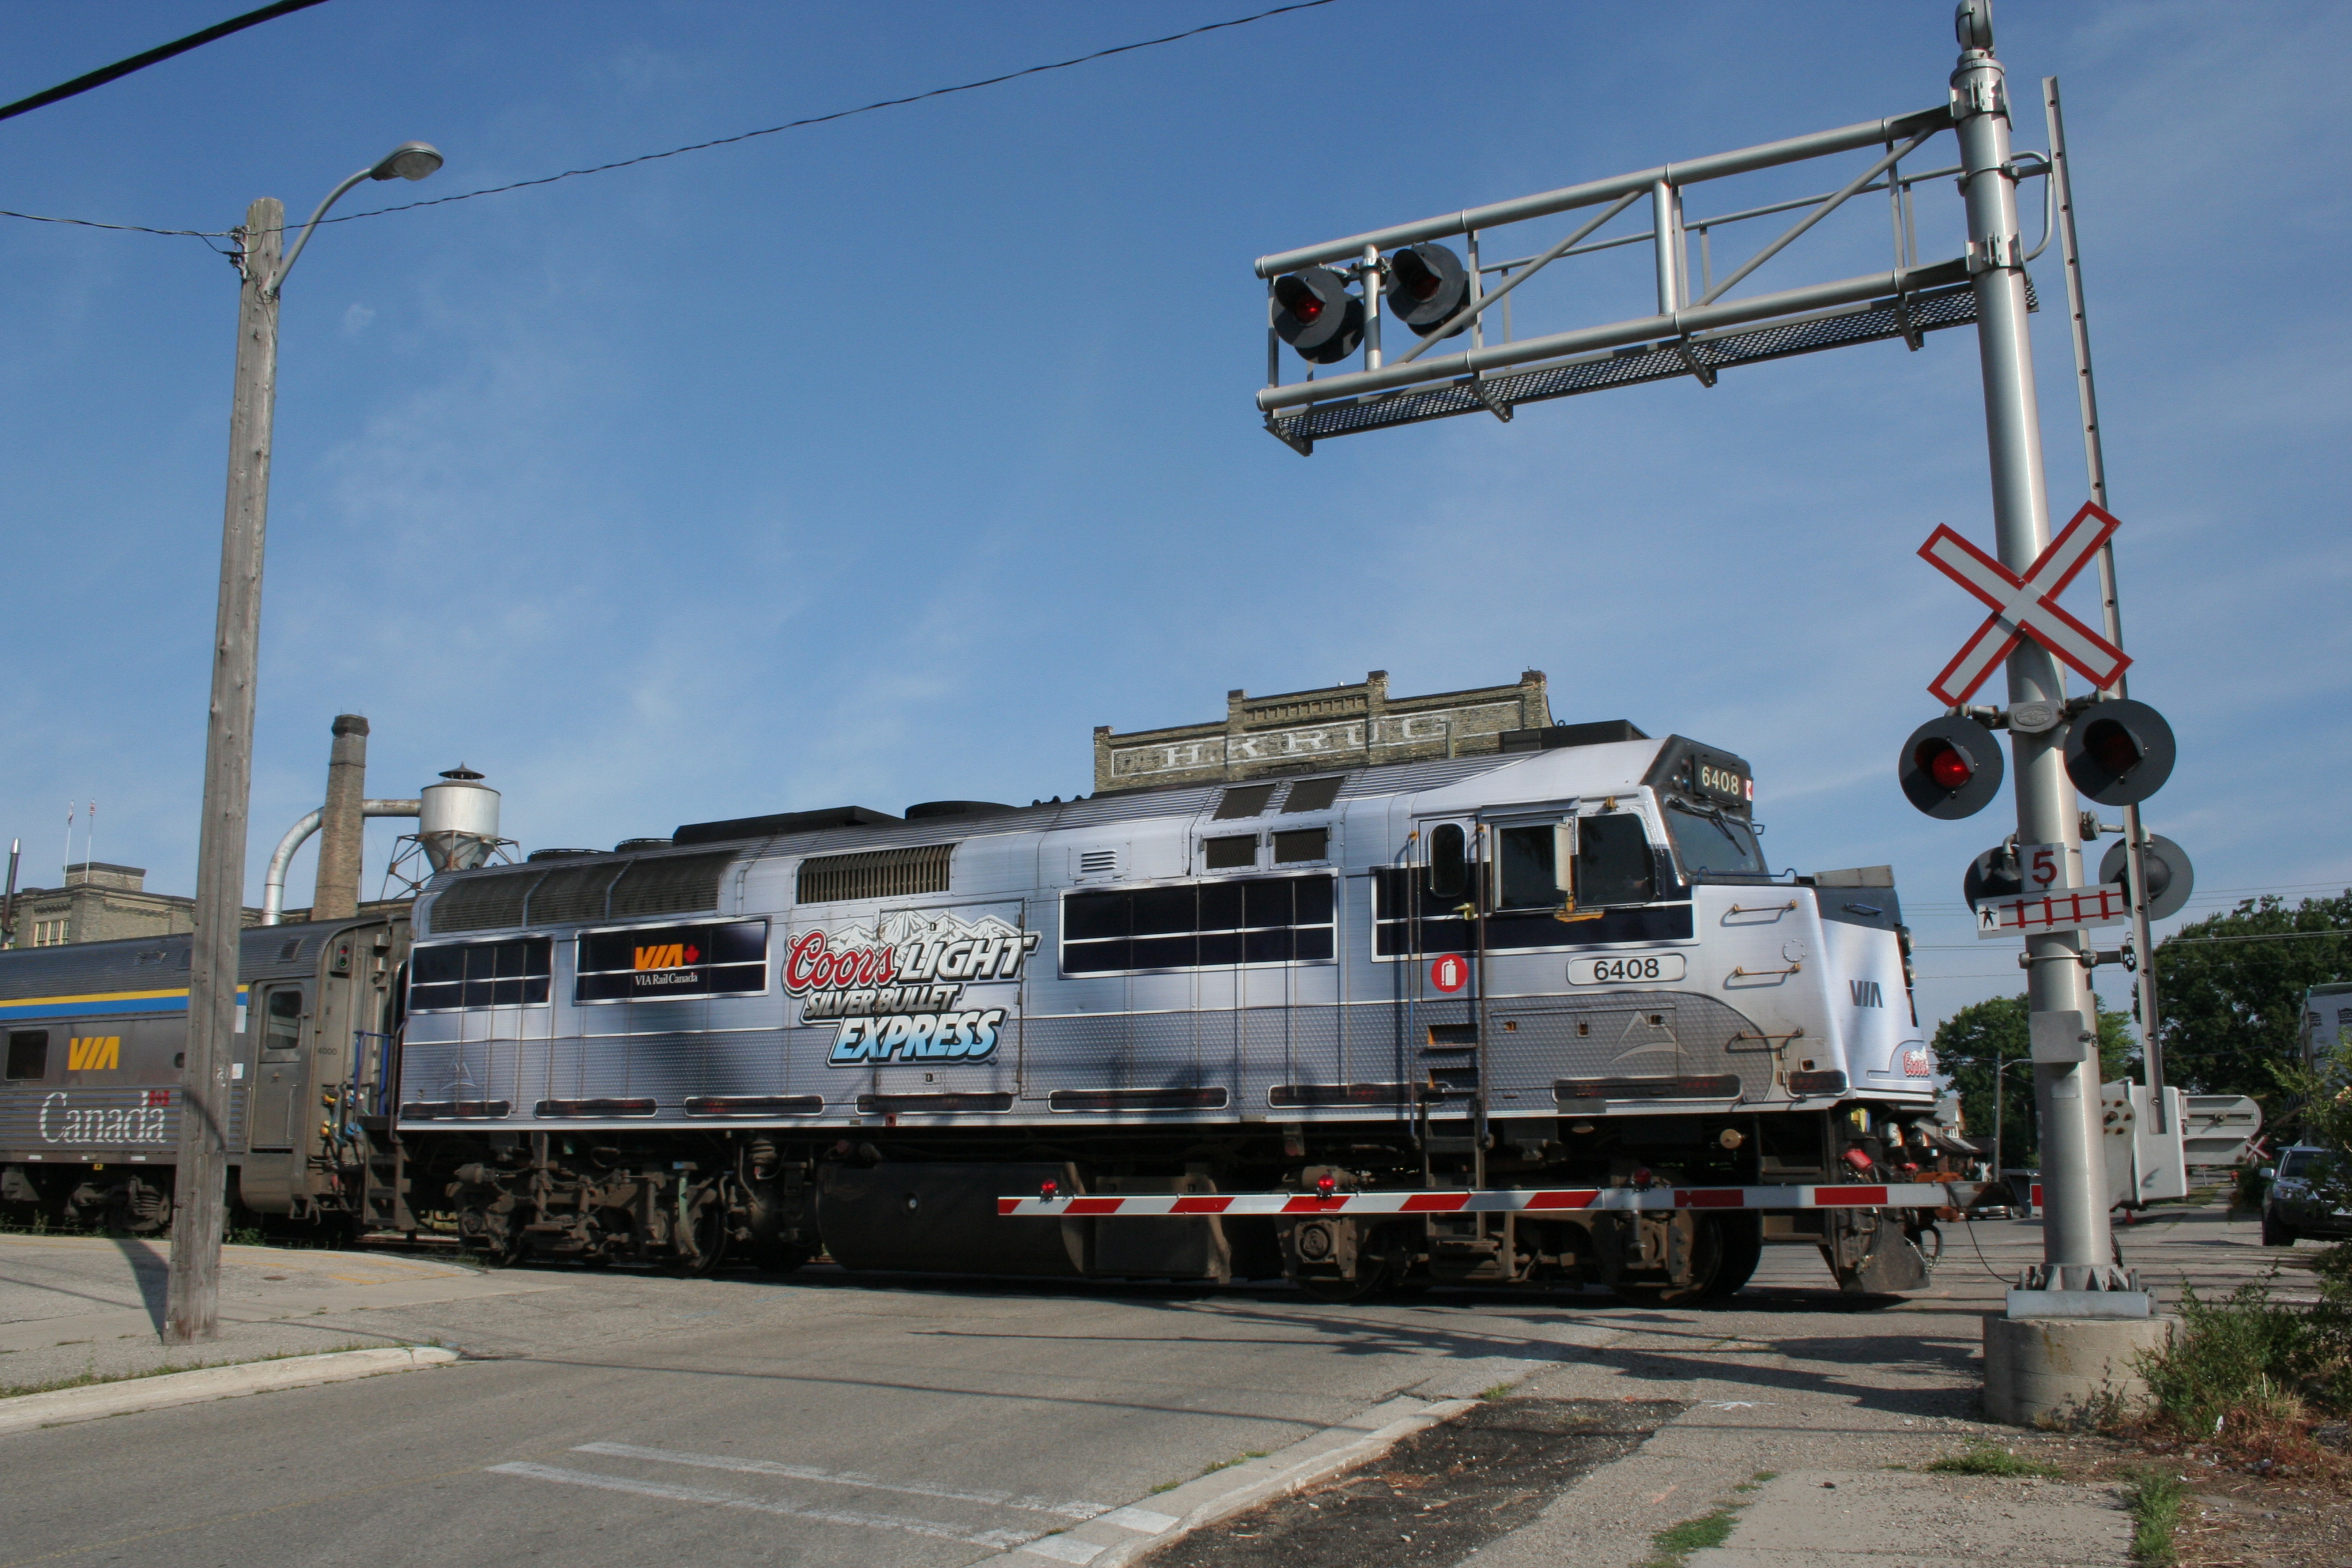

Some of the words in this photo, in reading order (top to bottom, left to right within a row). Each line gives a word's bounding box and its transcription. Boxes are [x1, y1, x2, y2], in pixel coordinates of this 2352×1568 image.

[1701, 766, 1740, 796] 6408
[2031, 850, 2058, 885] 5
[634, 943, 683, 970] VIA
[787, 930, 898, 988] Coors
[898, 935, 1038, 983] LIGHT
[1593, 958, 1660, 981] 6408
[635, 975, 651, 985] VIA
[653, 973, 668, 984] Rail
[669, 972, 698, 983] Canada
[1849, 979, 1883, 1008] VIA
[804, 989, 877, 1019] SILVER
[877, 983, 963, 1013] BULLET
[829, 1009, 1007, 1062] EXPRESS
[68, 1036, 120, 1071] VIA
[39, 1090, 167, 1143] Canada
